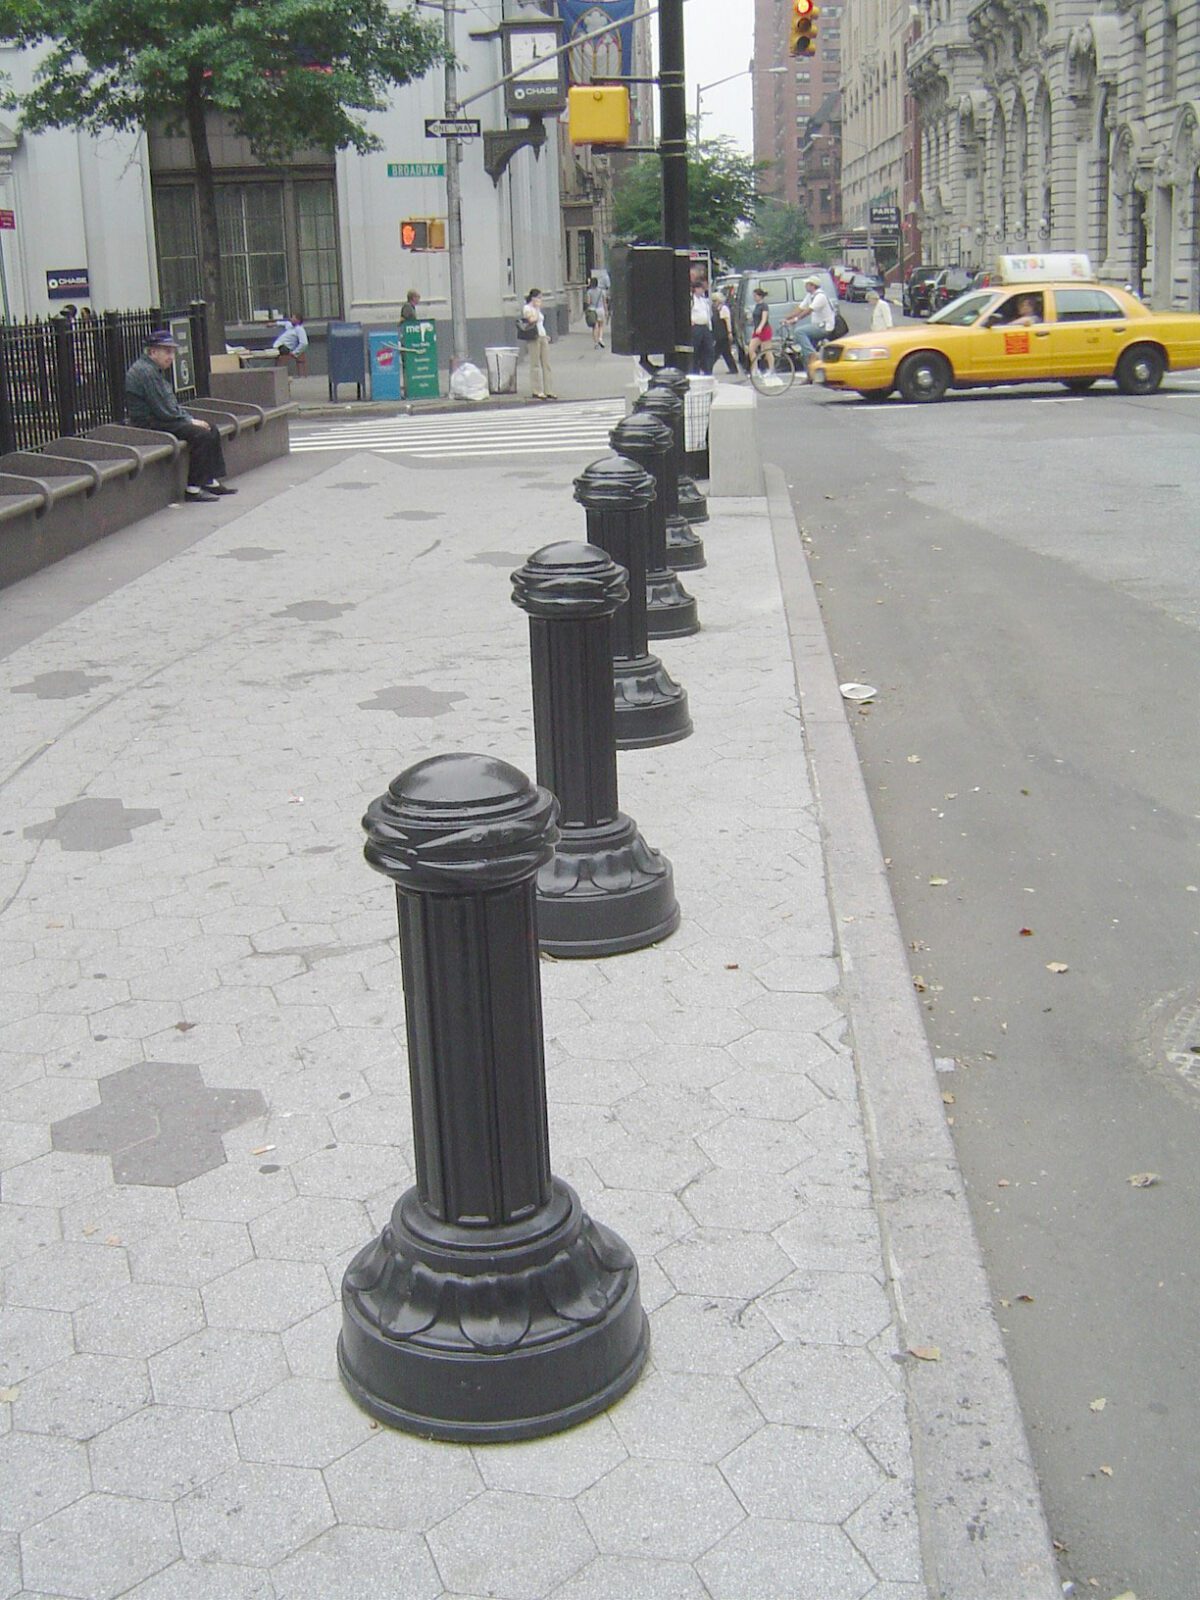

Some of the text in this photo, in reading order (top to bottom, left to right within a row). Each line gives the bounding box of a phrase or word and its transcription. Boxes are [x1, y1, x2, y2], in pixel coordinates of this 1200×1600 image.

[525, 86, 559, 96] CHASE
[391, 164, 439, 176] BROADWAY
[872, 207, 896, 215] PARK
[58, 277, 87, 285] CHASE
[405, 322, 434, 334] meo
